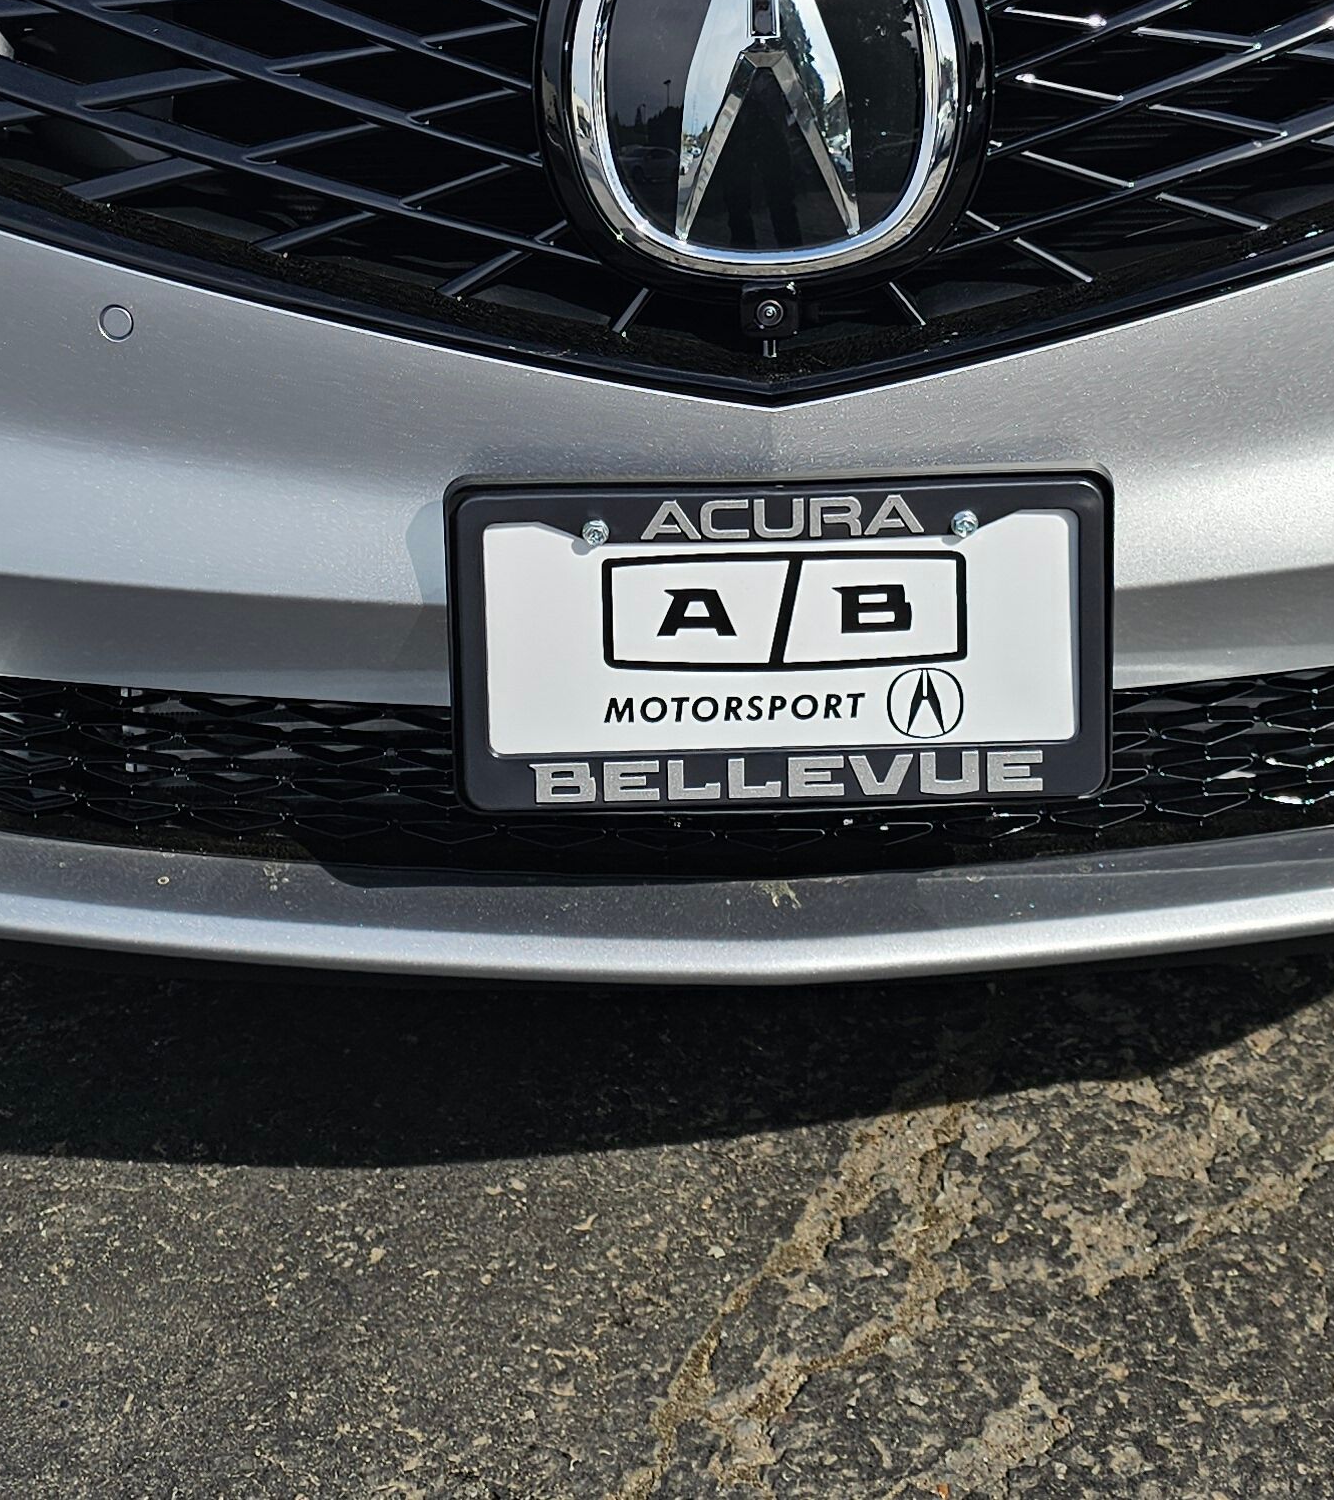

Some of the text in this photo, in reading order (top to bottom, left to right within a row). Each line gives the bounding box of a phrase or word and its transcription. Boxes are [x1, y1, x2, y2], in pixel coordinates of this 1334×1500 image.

[640, 494, 925, 540] ACURA
[656, 583, 913, 637] A B
[603, 692, 865, 724] MOTORSPORT
[529, 750, 1045, 803] BELLEVUE
